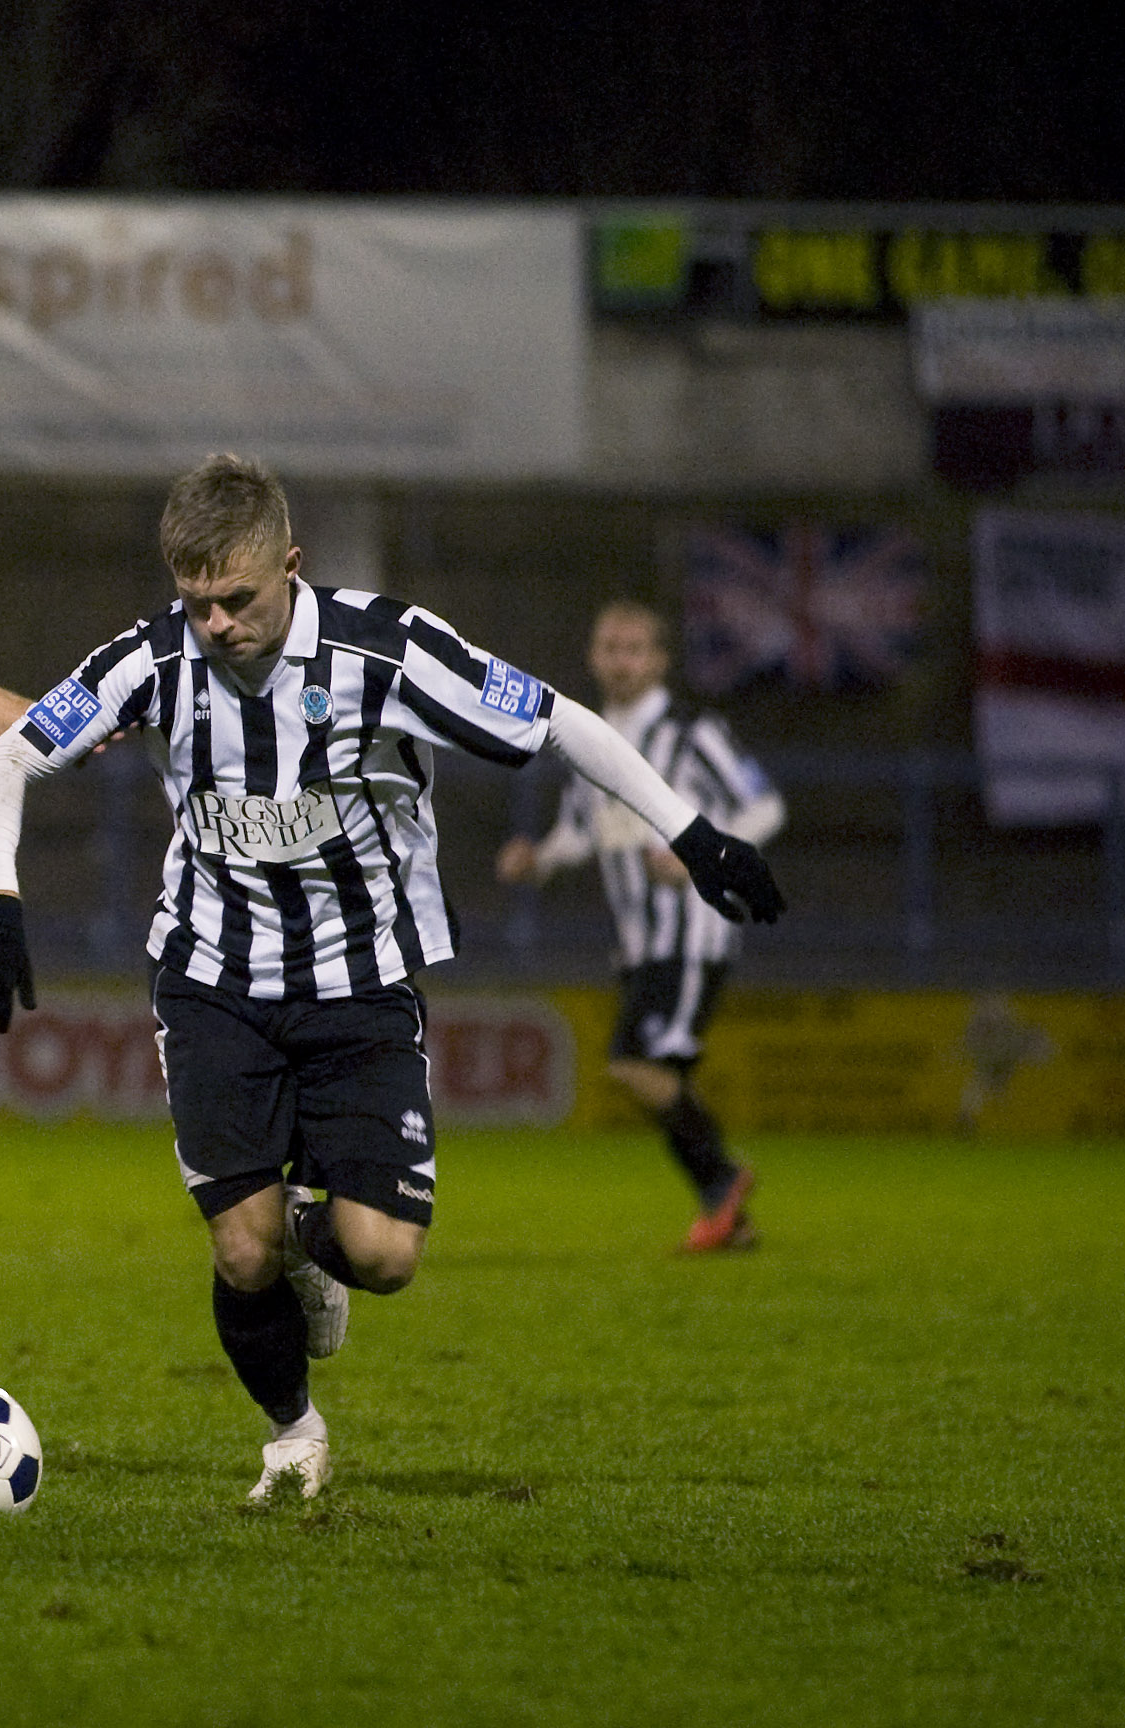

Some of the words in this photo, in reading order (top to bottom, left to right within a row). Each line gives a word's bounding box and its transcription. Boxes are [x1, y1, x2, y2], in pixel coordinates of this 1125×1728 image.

[57, 680, 98, 719] BLUE
[484, 659, 508, 708] BLUE
[500, 679, 524, 714] SQ
[34, 710, 66, 741] SOUTH
[43, 692, 72, 720] SQ
[191, 789, 324, 830] PUGSLEY
[210, 812, 324, 859] REVILL
